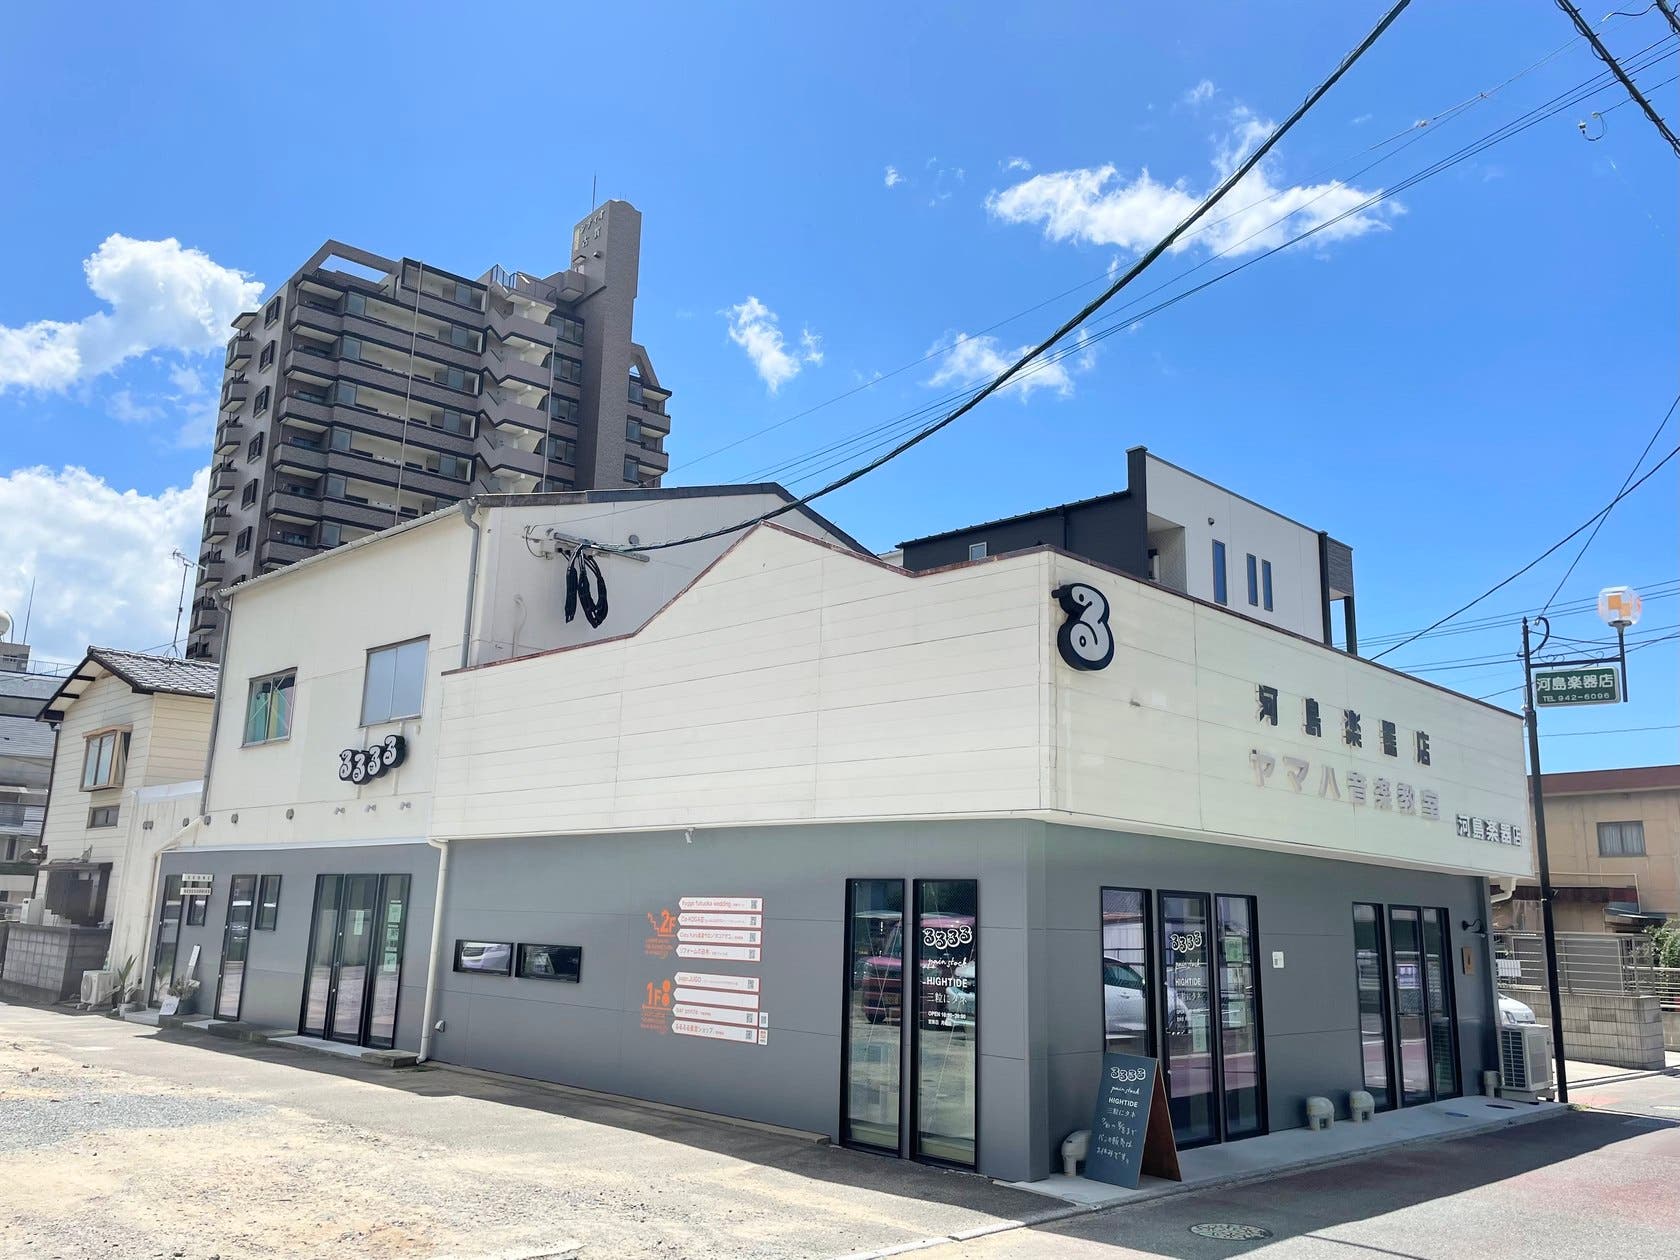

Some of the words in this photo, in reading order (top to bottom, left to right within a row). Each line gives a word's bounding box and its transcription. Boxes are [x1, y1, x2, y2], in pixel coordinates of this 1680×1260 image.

[1537, 674, 1613, 691] 河島楽器店
[1257, 684, 1432, 767] 河島楽器店
[339, 735, 405, 785] 3333
[1251, 749, 1440, 821] ヤマハ音楽教室
[1456, 814, 1521, 847] 河島楽器店
[923, 926, 973, 950] 3333
[1170, 931, 1202, 953] 3333
[926, 976, 968, 988] HIGHTIDE
[1111, 1067, 1146, 1081] 3333
[1108, 1097, 1138, 1108] HIGHTIDE
